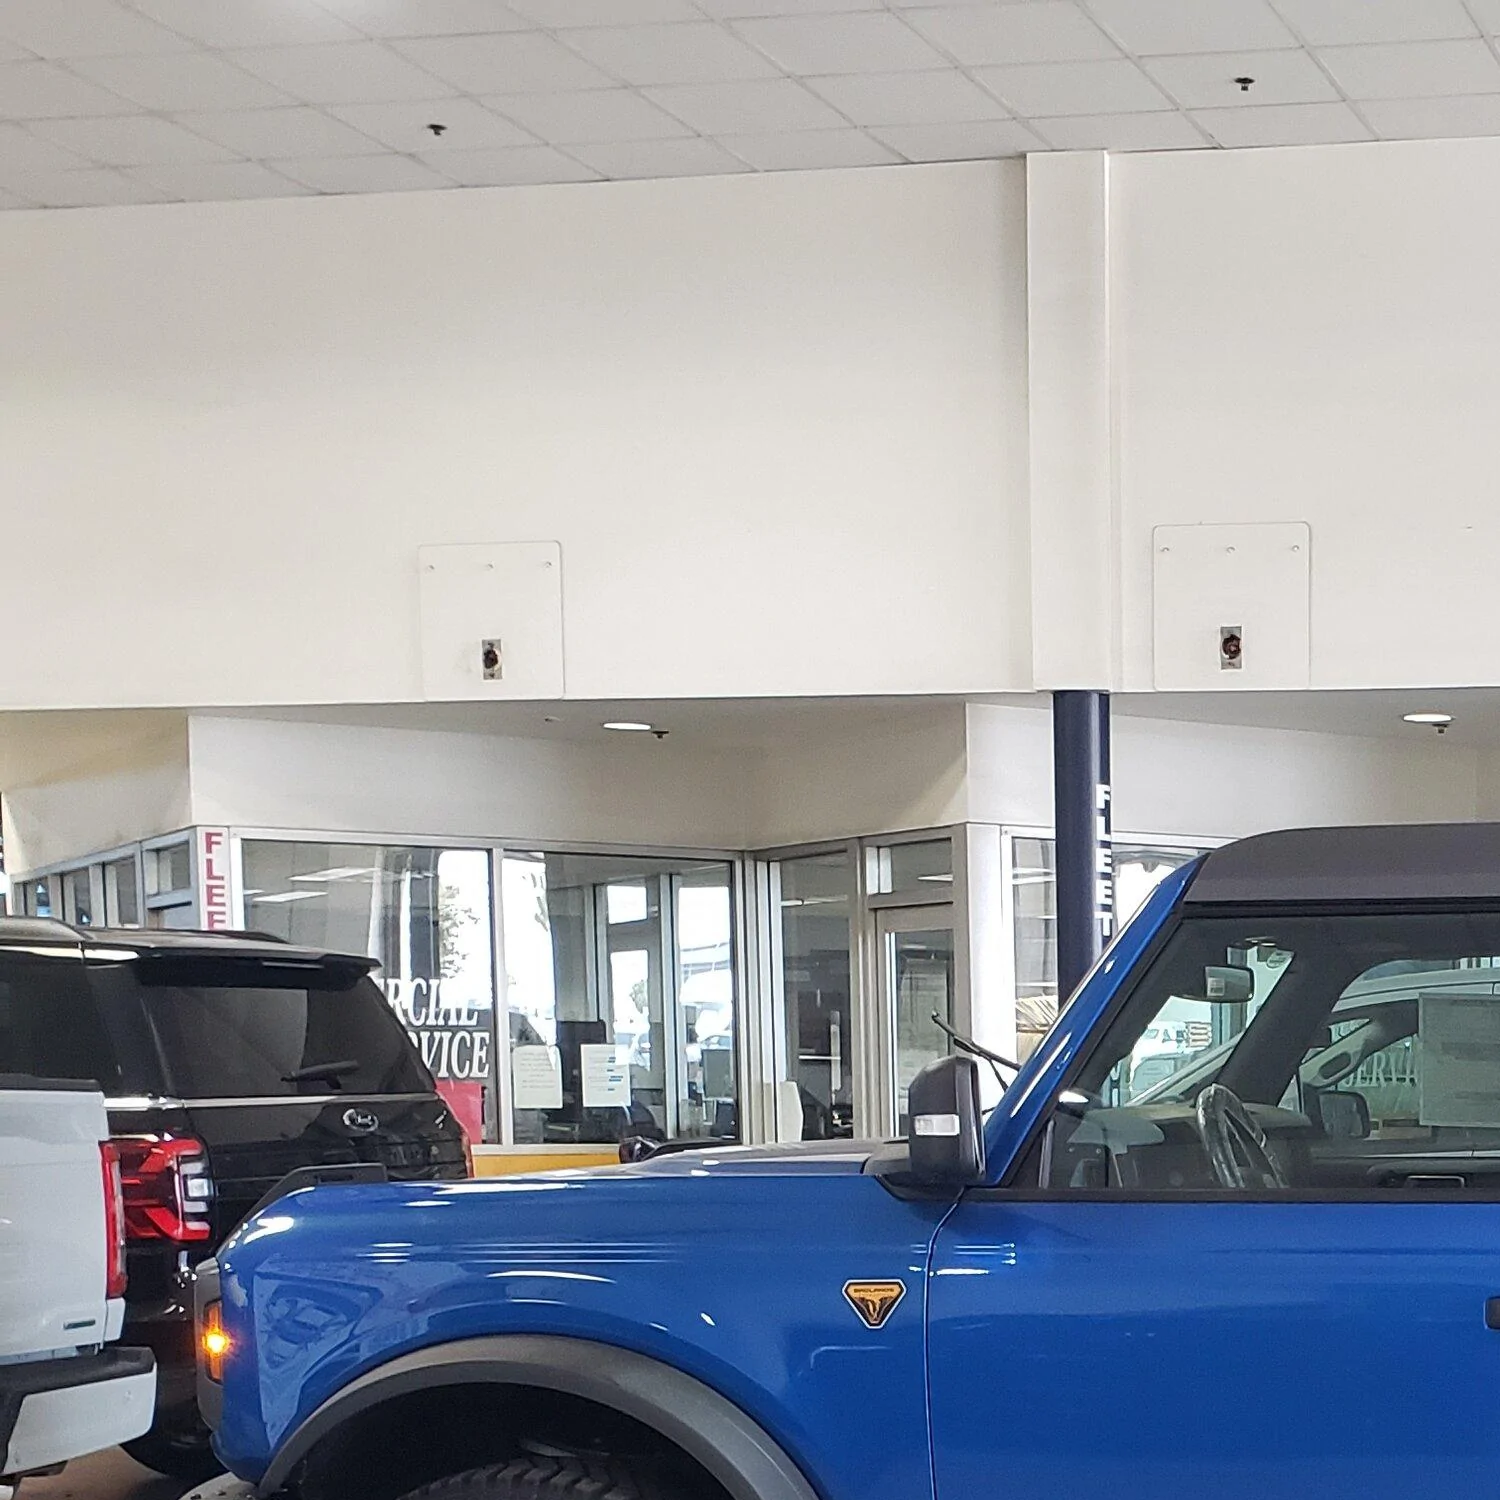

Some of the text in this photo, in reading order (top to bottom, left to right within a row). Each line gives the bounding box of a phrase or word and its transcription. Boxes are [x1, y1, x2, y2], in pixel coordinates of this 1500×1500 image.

[205, 832, 226, 931] FLEE
[1095, 784, 1113, 937] FLEET
[408, 1030, 490, 1079] VICE
